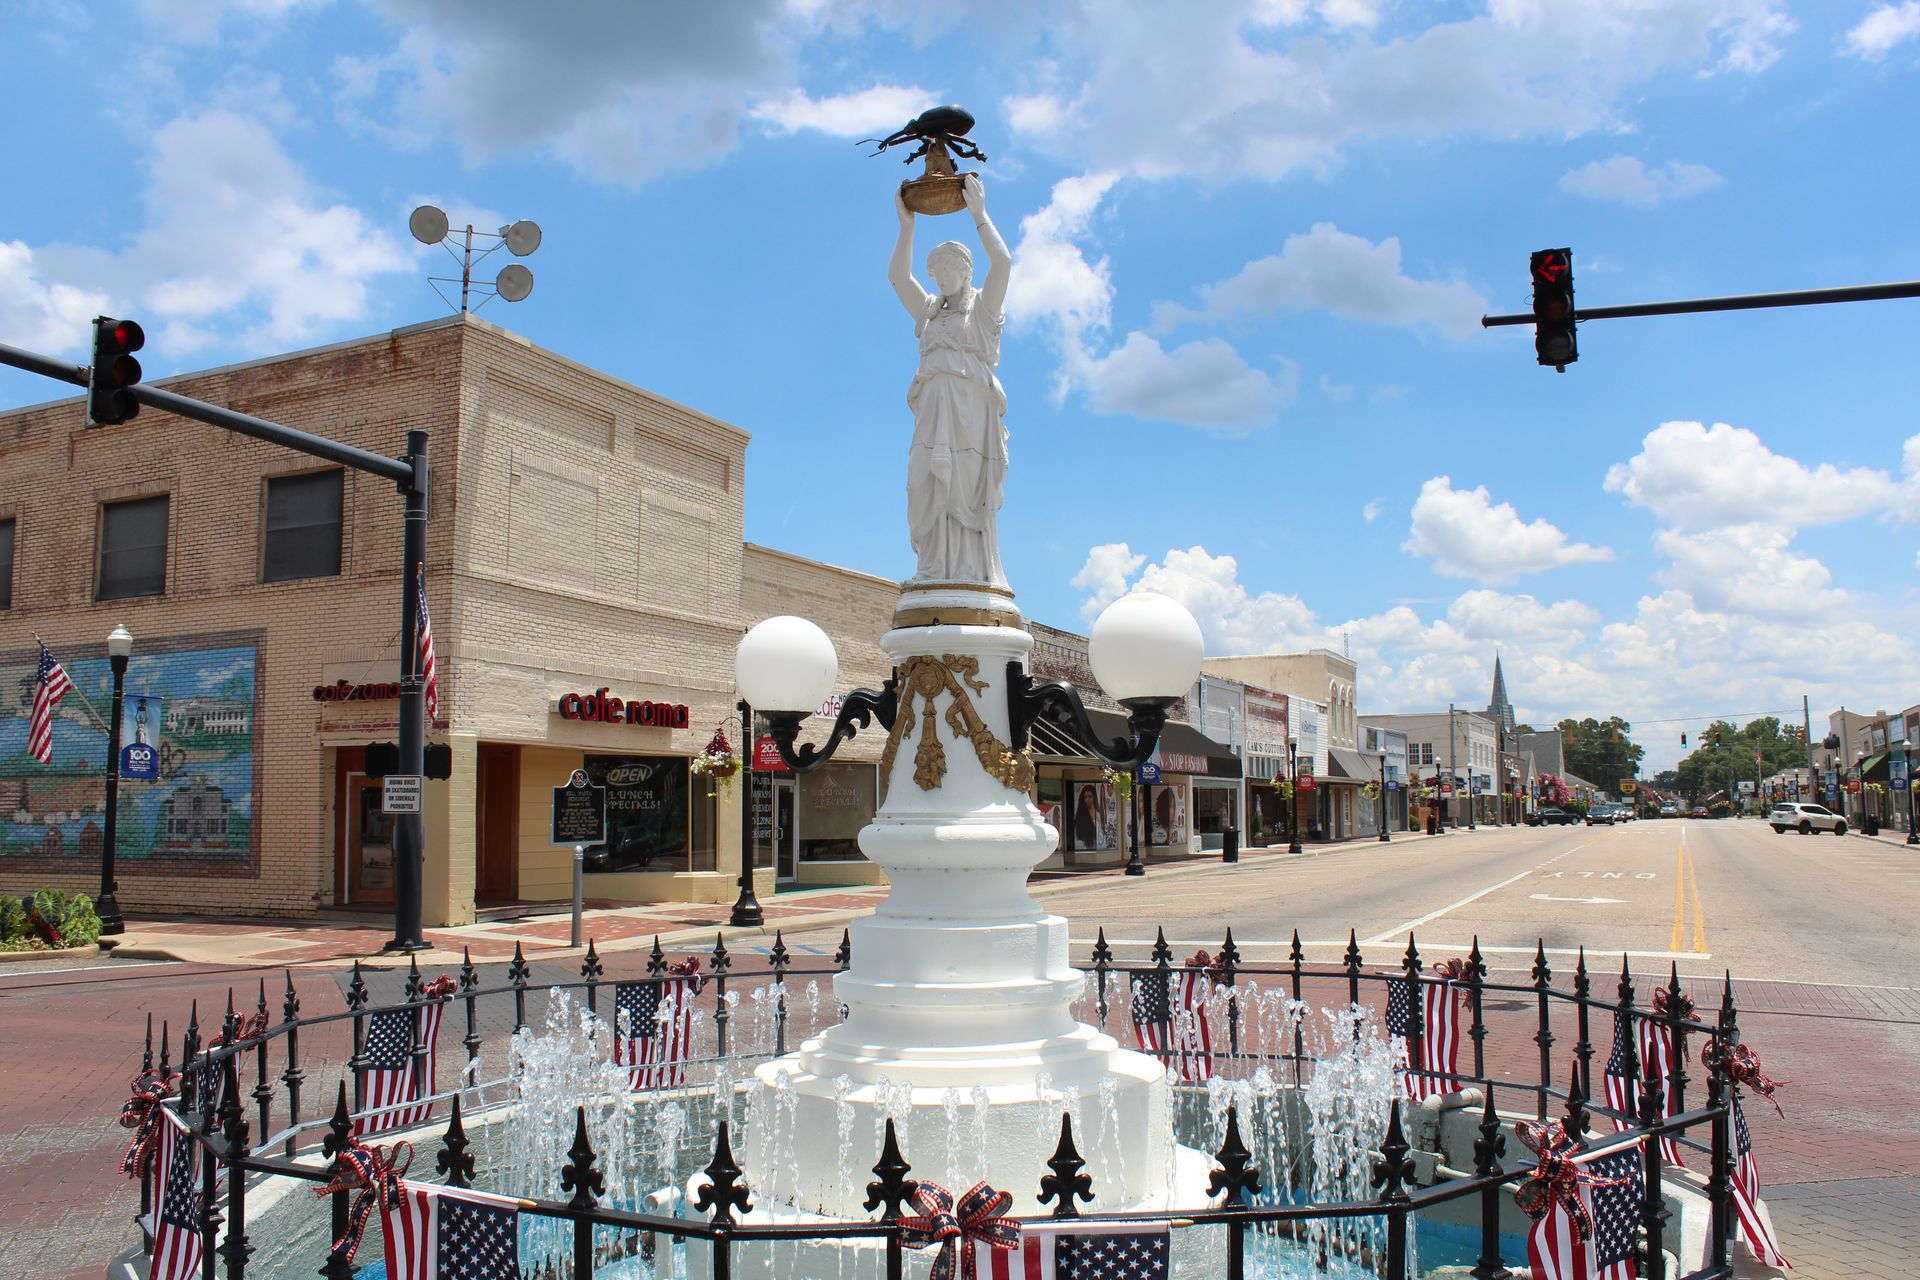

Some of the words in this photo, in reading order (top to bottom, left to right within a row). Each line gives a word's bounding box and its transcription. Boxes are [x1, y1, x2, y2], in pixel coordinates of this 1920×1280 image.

[559, 687, 624, 724] cafe
[626, 700, 689, 729] roma
[130, 750, 151, 760] 100
[610, 768, 648, 781] OPEN
[608, 790, 653, 800] LUNCH
[1540, 871, 1657, 880] ONLY
